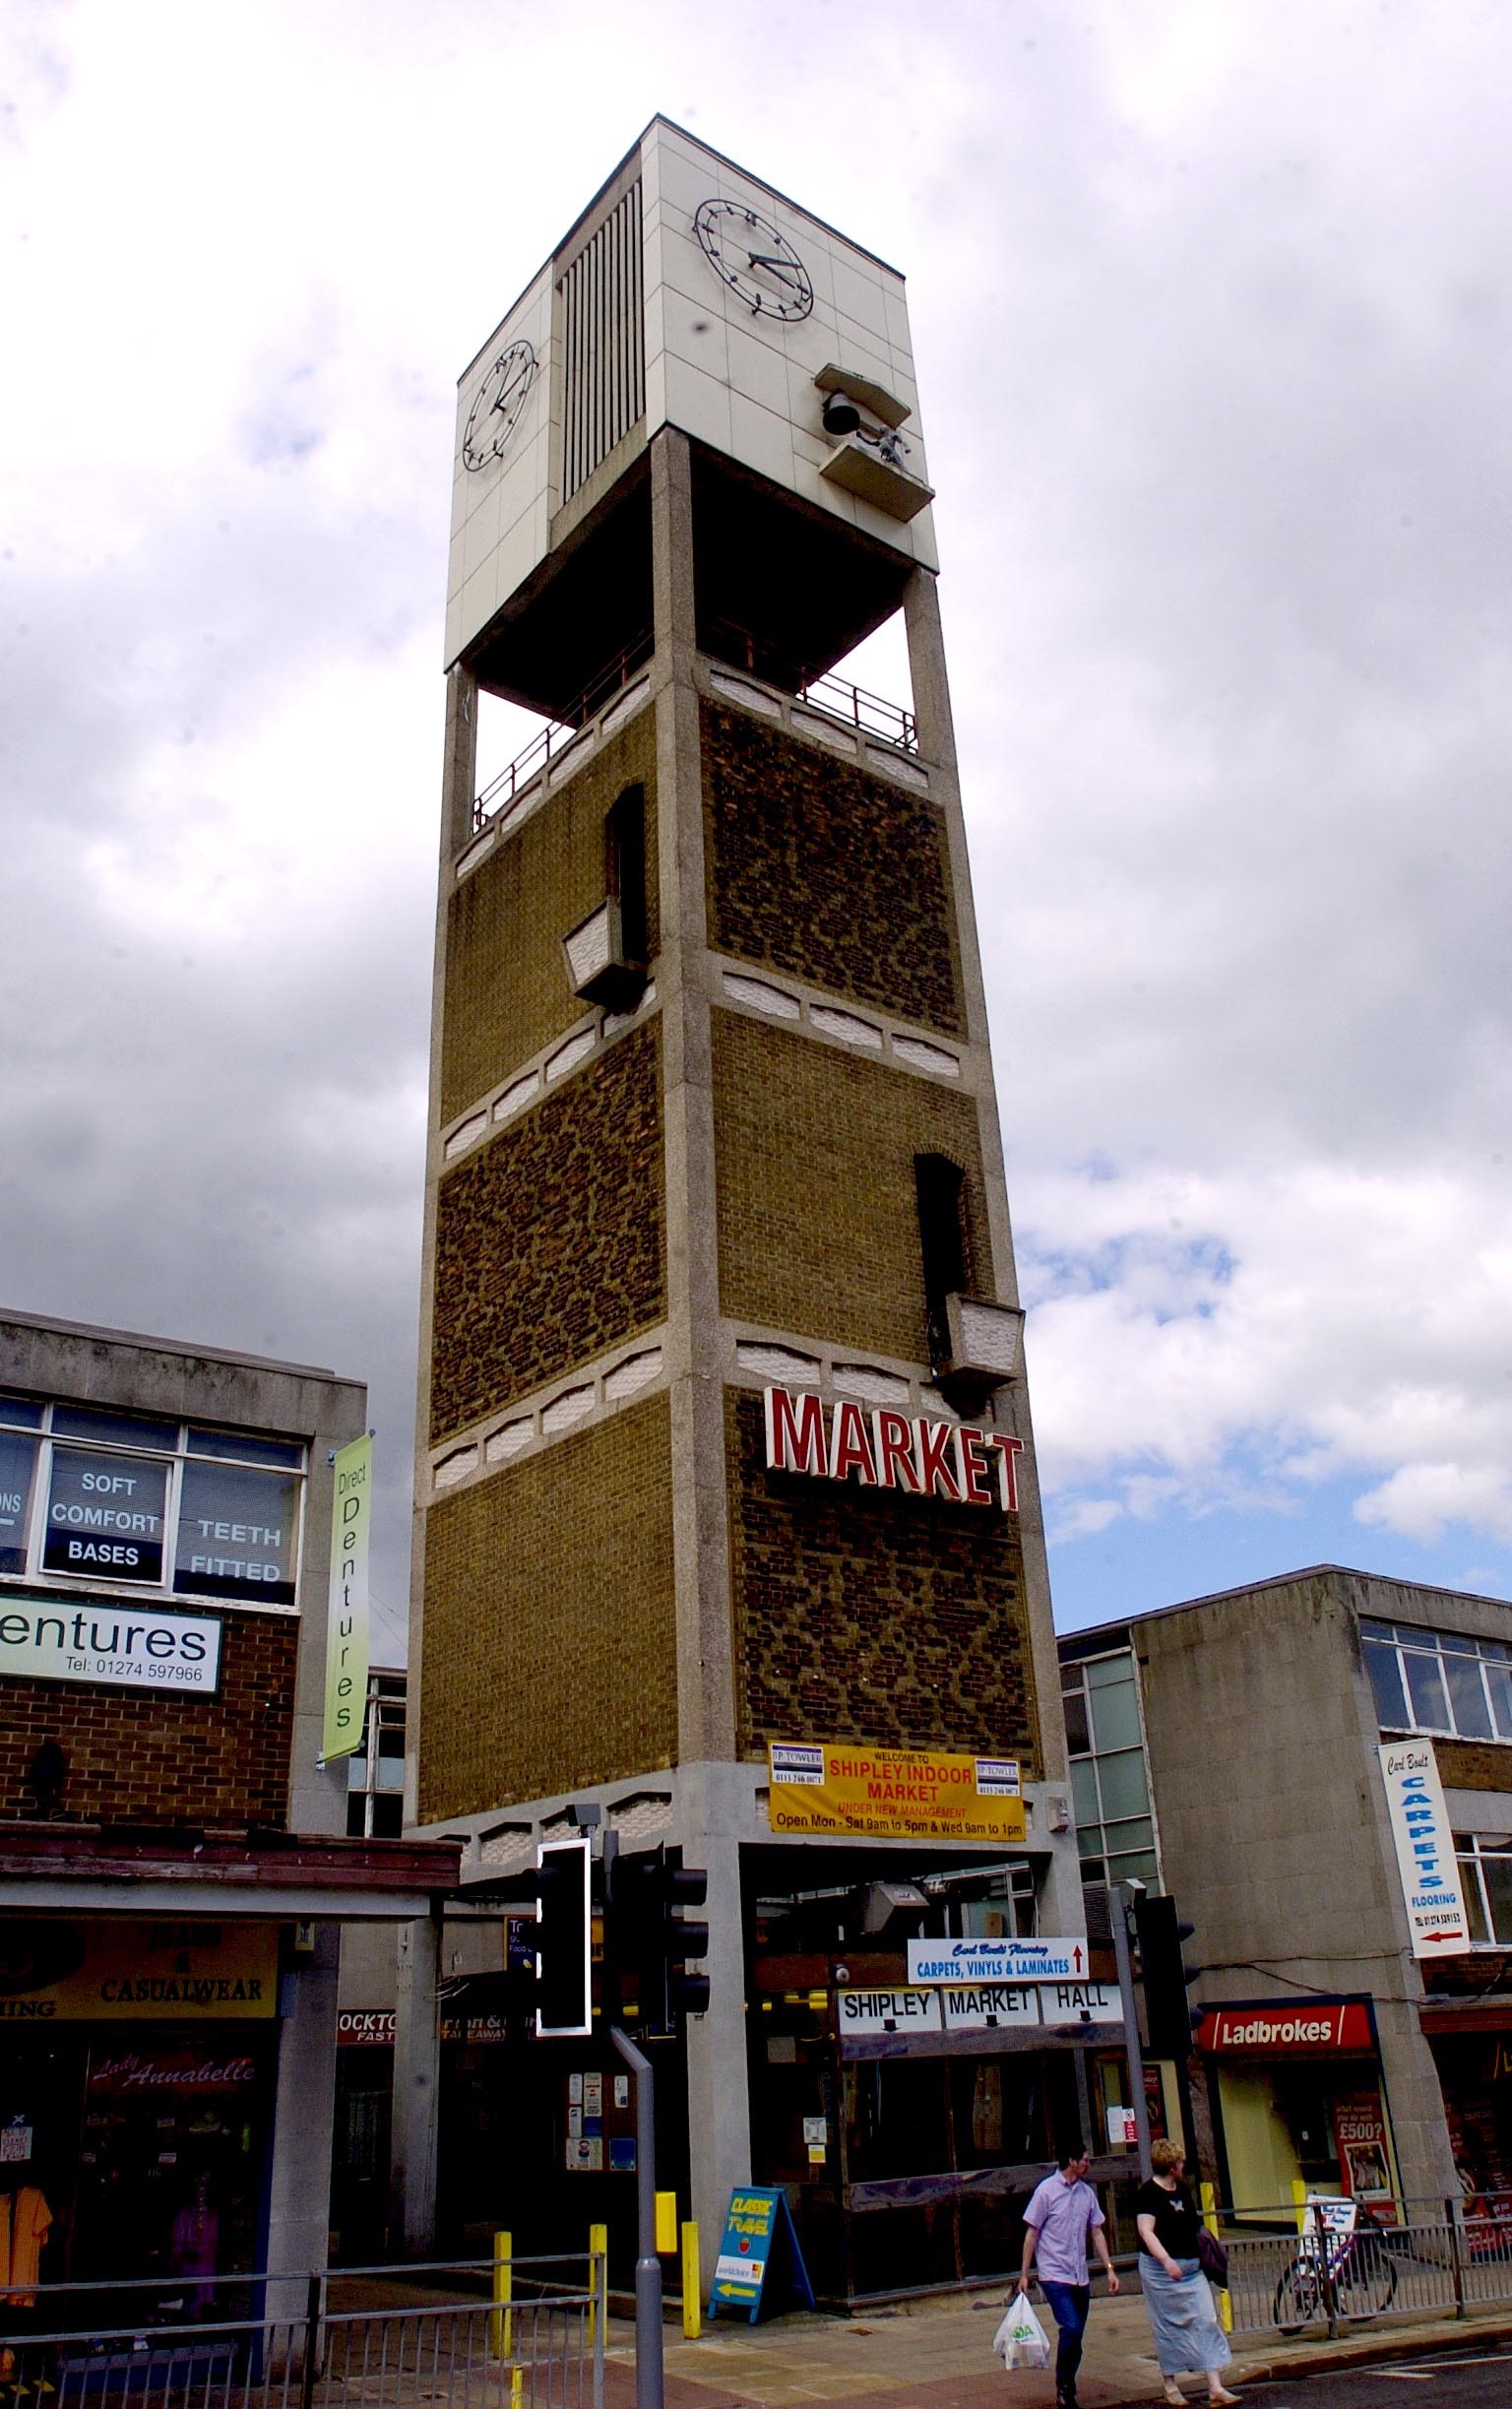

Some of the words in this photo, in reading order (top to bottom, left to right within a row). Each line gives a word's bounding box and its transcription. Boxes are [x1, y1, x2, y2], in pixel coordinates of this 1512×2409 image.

[764, 1386, 1025, 1512] MARKET
[82, 1473, 137, 1496] SOFT
[339, 1464, 366, 1494] Direct
[0, 1492, 22, 1513] NS
[51, 1503, 158, 1533] COMFORT
[198, 1519, 281, 1547] TEETH
[68, 1541, 139, 1566] BASES
[190, 1555, 281, 1582] FITTED
[337, 1496, 360, 1728] Dentures
[66, 1656, 91, 1673] Tel:
[96, 1659, 143, 1677] 01274
[148, 1664, 203, 1681] 597966
[874, 1751, 915, 1763] WELCOME
[917, 1753, 929, 1764] TO
[829, 1759, 904, 1781] SHIPLEY
[907, 1766, 973, 1785] INDOOR
[867, 1782, 938, 1803] MARKET
[838, 1803, 873, 1814] UNDER
[875, 1804, 897, 1815] NEW
[900, 1806, 967, 1819] MANAGEMENT
[777, 1813, 808, 1828] Open
[811, 1815, 836, 1827] Mon
[846, 1816, 864, 1829] Sat
[867, 1818, 889, 1830] 9am
[891, 1818, 902, 1830] to
[905, 1819, 927, 1833] 5pm
[931, 1821, 938, 1832] &
[941, 1821, 963, 1833] Wed
[965, 1823, 985, 1834] 9am
[988, 1824, 998, 1834] to
[1002, 1824, 1023, 1837] 1pm
[1402, 1777, 1443, 1888] CARPETS
[1412, 1892, 1456, 1907] FLOORING
[917, 1961, 965, 1979] CARPETS,
[967, 1960, 1003, 1976] VINYLS
[1006, 1960, 1013, 1975] &
[1016, 1959, 1070, 1975] LAMINATES
[101, 1979, 263, 2002] CASUALWEAR
[845, 1992, 930, 2018] SHIPLEY
[949, 1987, 1030, 2014] MARKET
[1057, 1984, 1108, 2008] HALL
[357, 2032, 395, 2042] FAST
[1223, 2019, 1332, 2044] Ladbrokes
[122, 2058, 257, 2087] Annabelle
[1339, 2122, 1383, 2139] £500?
